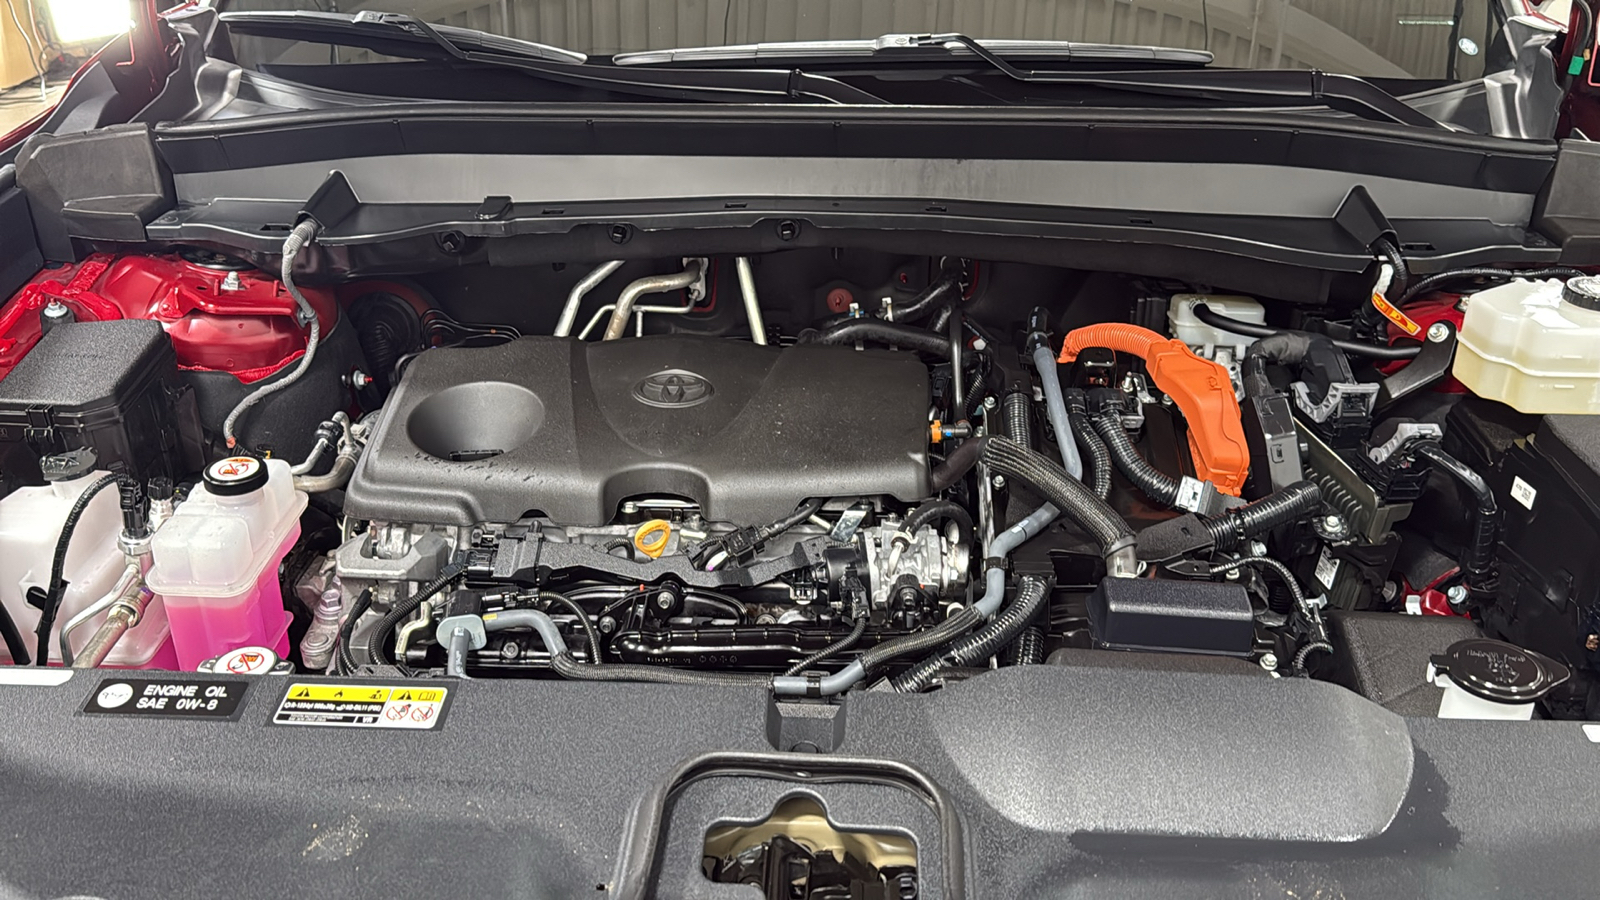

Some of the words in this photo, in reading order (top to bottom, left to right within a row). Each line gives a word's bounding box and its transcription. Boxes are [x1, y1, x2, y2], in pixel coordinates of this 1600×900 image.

[143, 684, 198, 697] ENGINE
[205, 686, 228, 698] OIL
[136, 697, 168, 709] SAE
[175, 698, 218, 711] 0W-8
